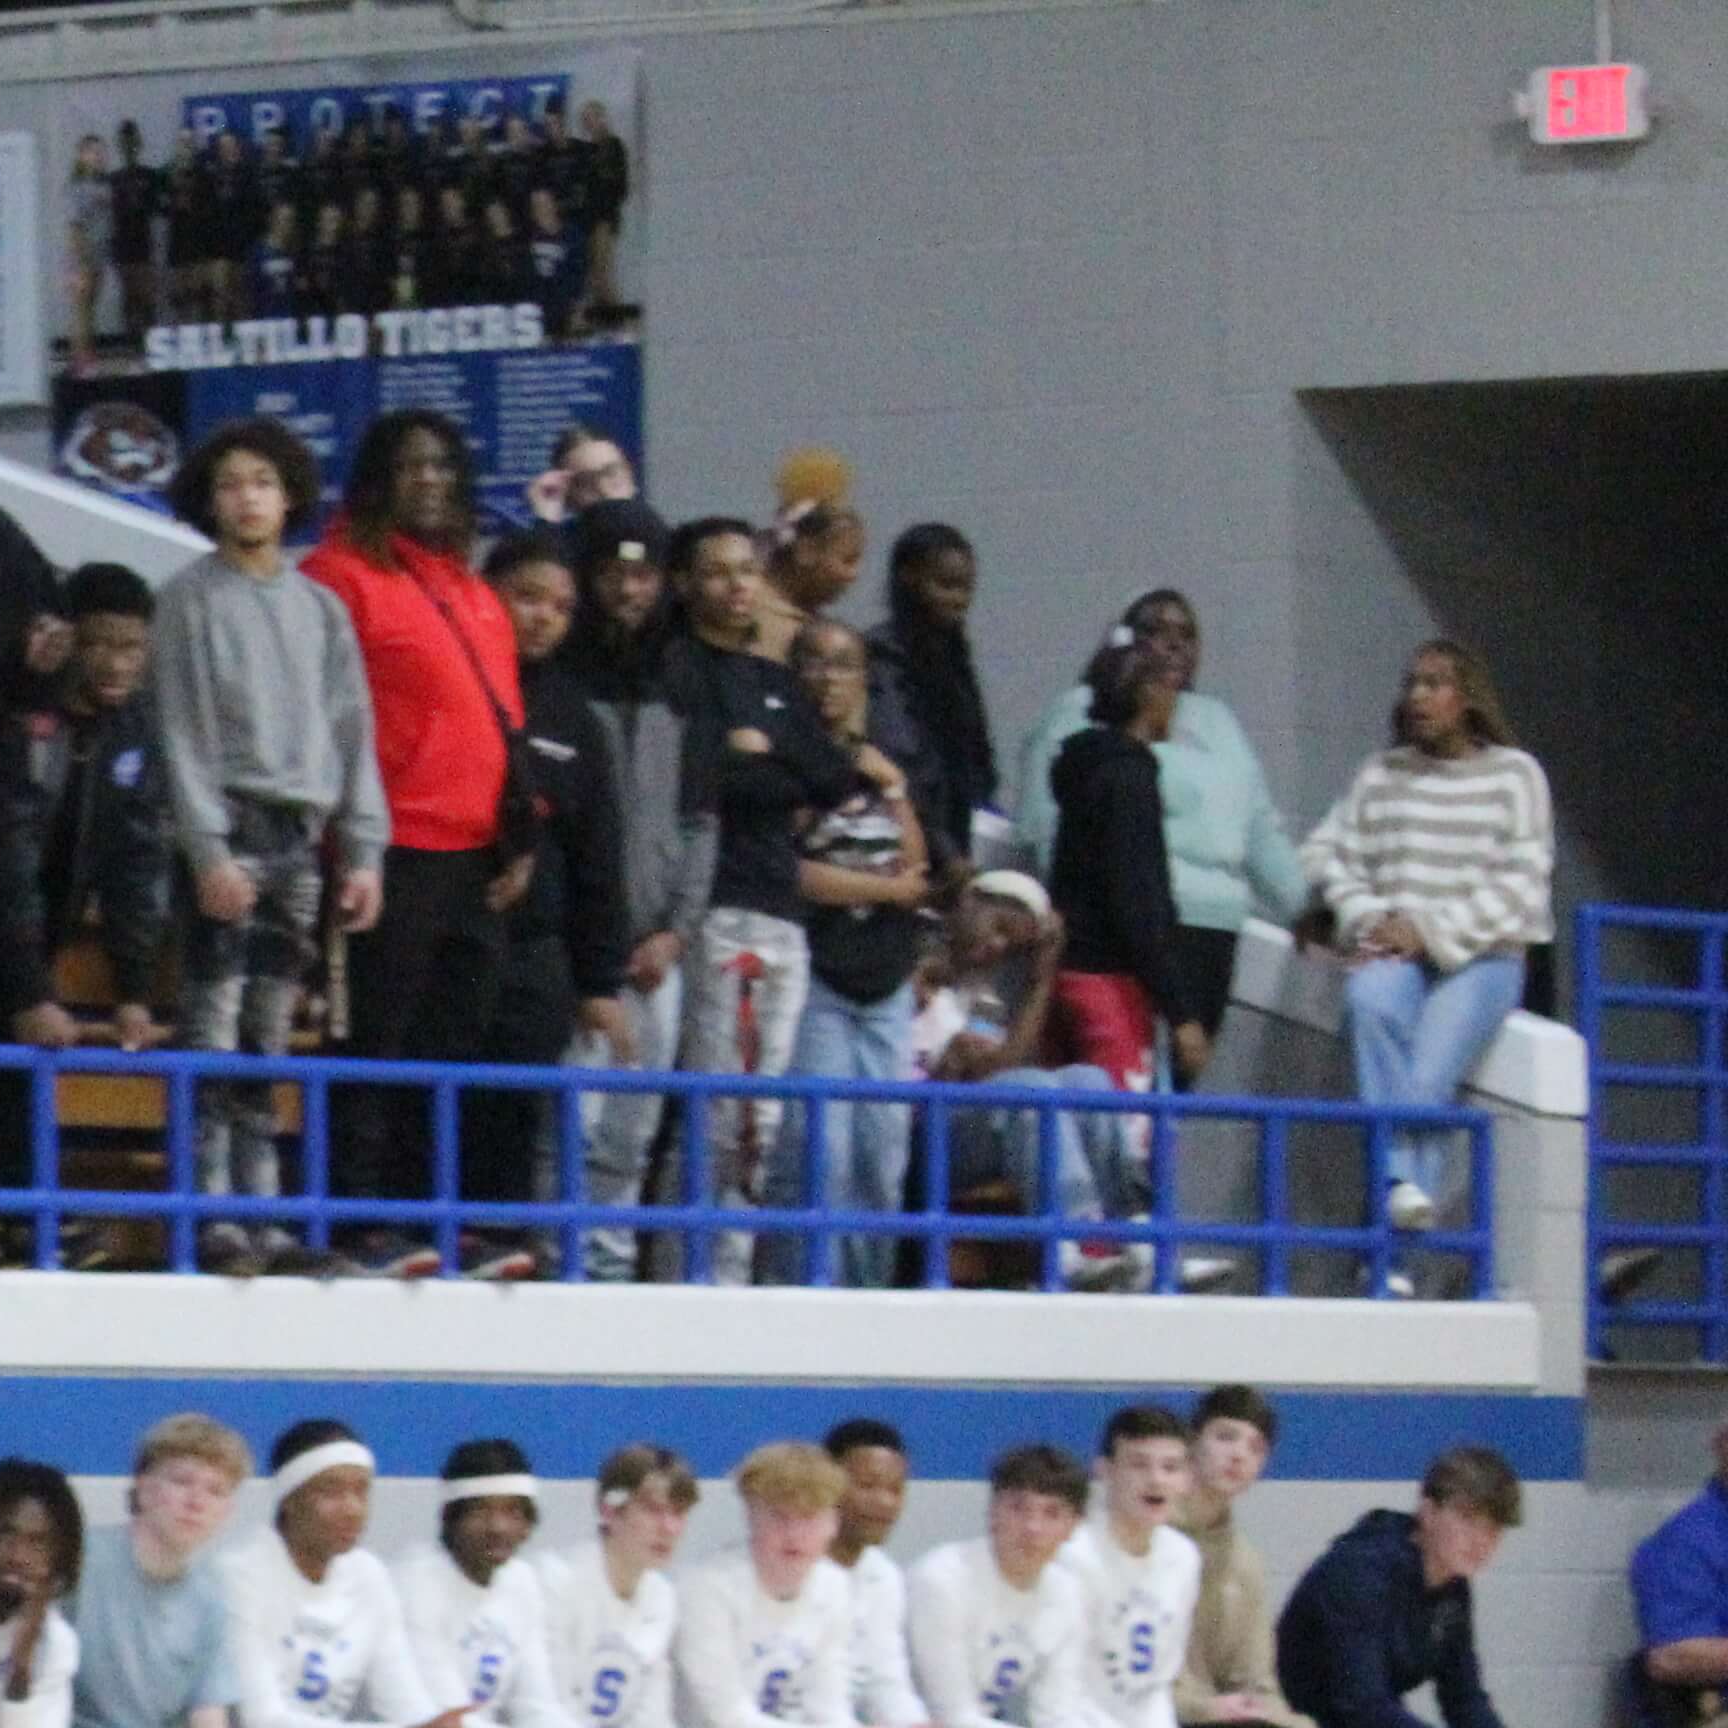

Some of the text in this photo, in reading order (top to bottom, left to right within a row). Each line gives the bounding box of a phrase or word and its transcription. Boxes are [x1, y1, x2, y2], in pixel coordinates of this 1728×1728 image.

[1548, 66, 1631, 137] EXIT
[144, 302, 544, 372] SALTILLO TIGERS
[590, 1668, 627, 1718] S
